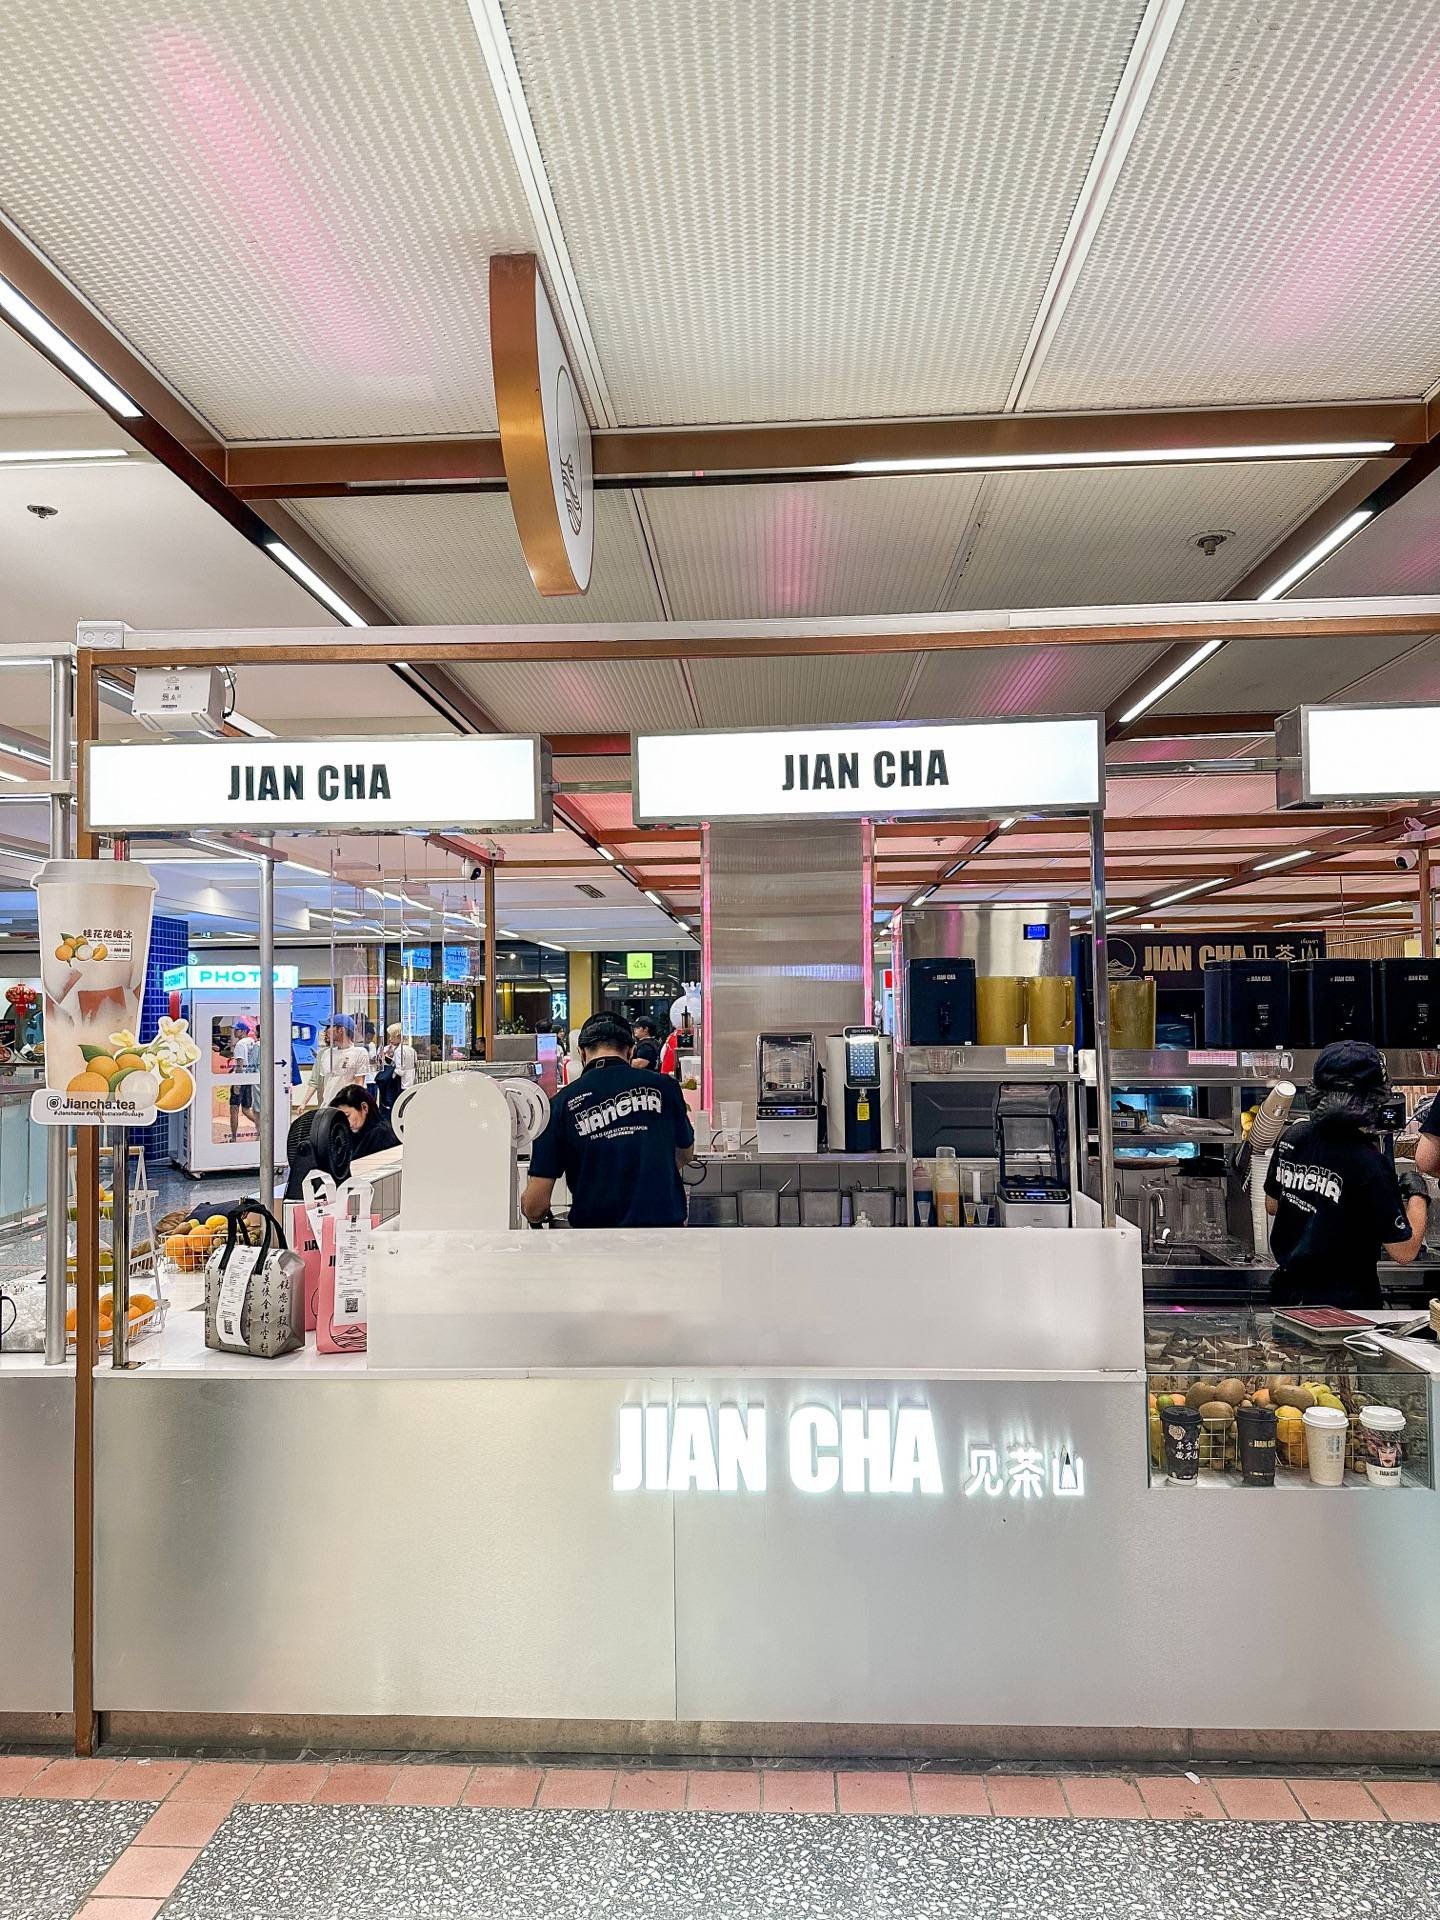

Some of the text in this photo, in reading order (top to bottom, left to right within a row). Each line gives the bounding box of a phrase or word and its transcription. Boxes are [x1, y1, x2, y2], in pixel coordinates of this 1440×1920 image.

[227, 763, 391, 801] JIAN CHA
[780, 749, 950, 791] JIAN CHA
[1142, 944, 1247, 972] JIAN CHA
[62, 1098, 136, 1110] Jiancha.tea
[303, 1239, 319, 1252] JIA
[328, 1255, 336, 1267] JI
[612, 1402, 944, 1492] JIAN CHA
[963, 1444, 1086, 1498] 见茶山
